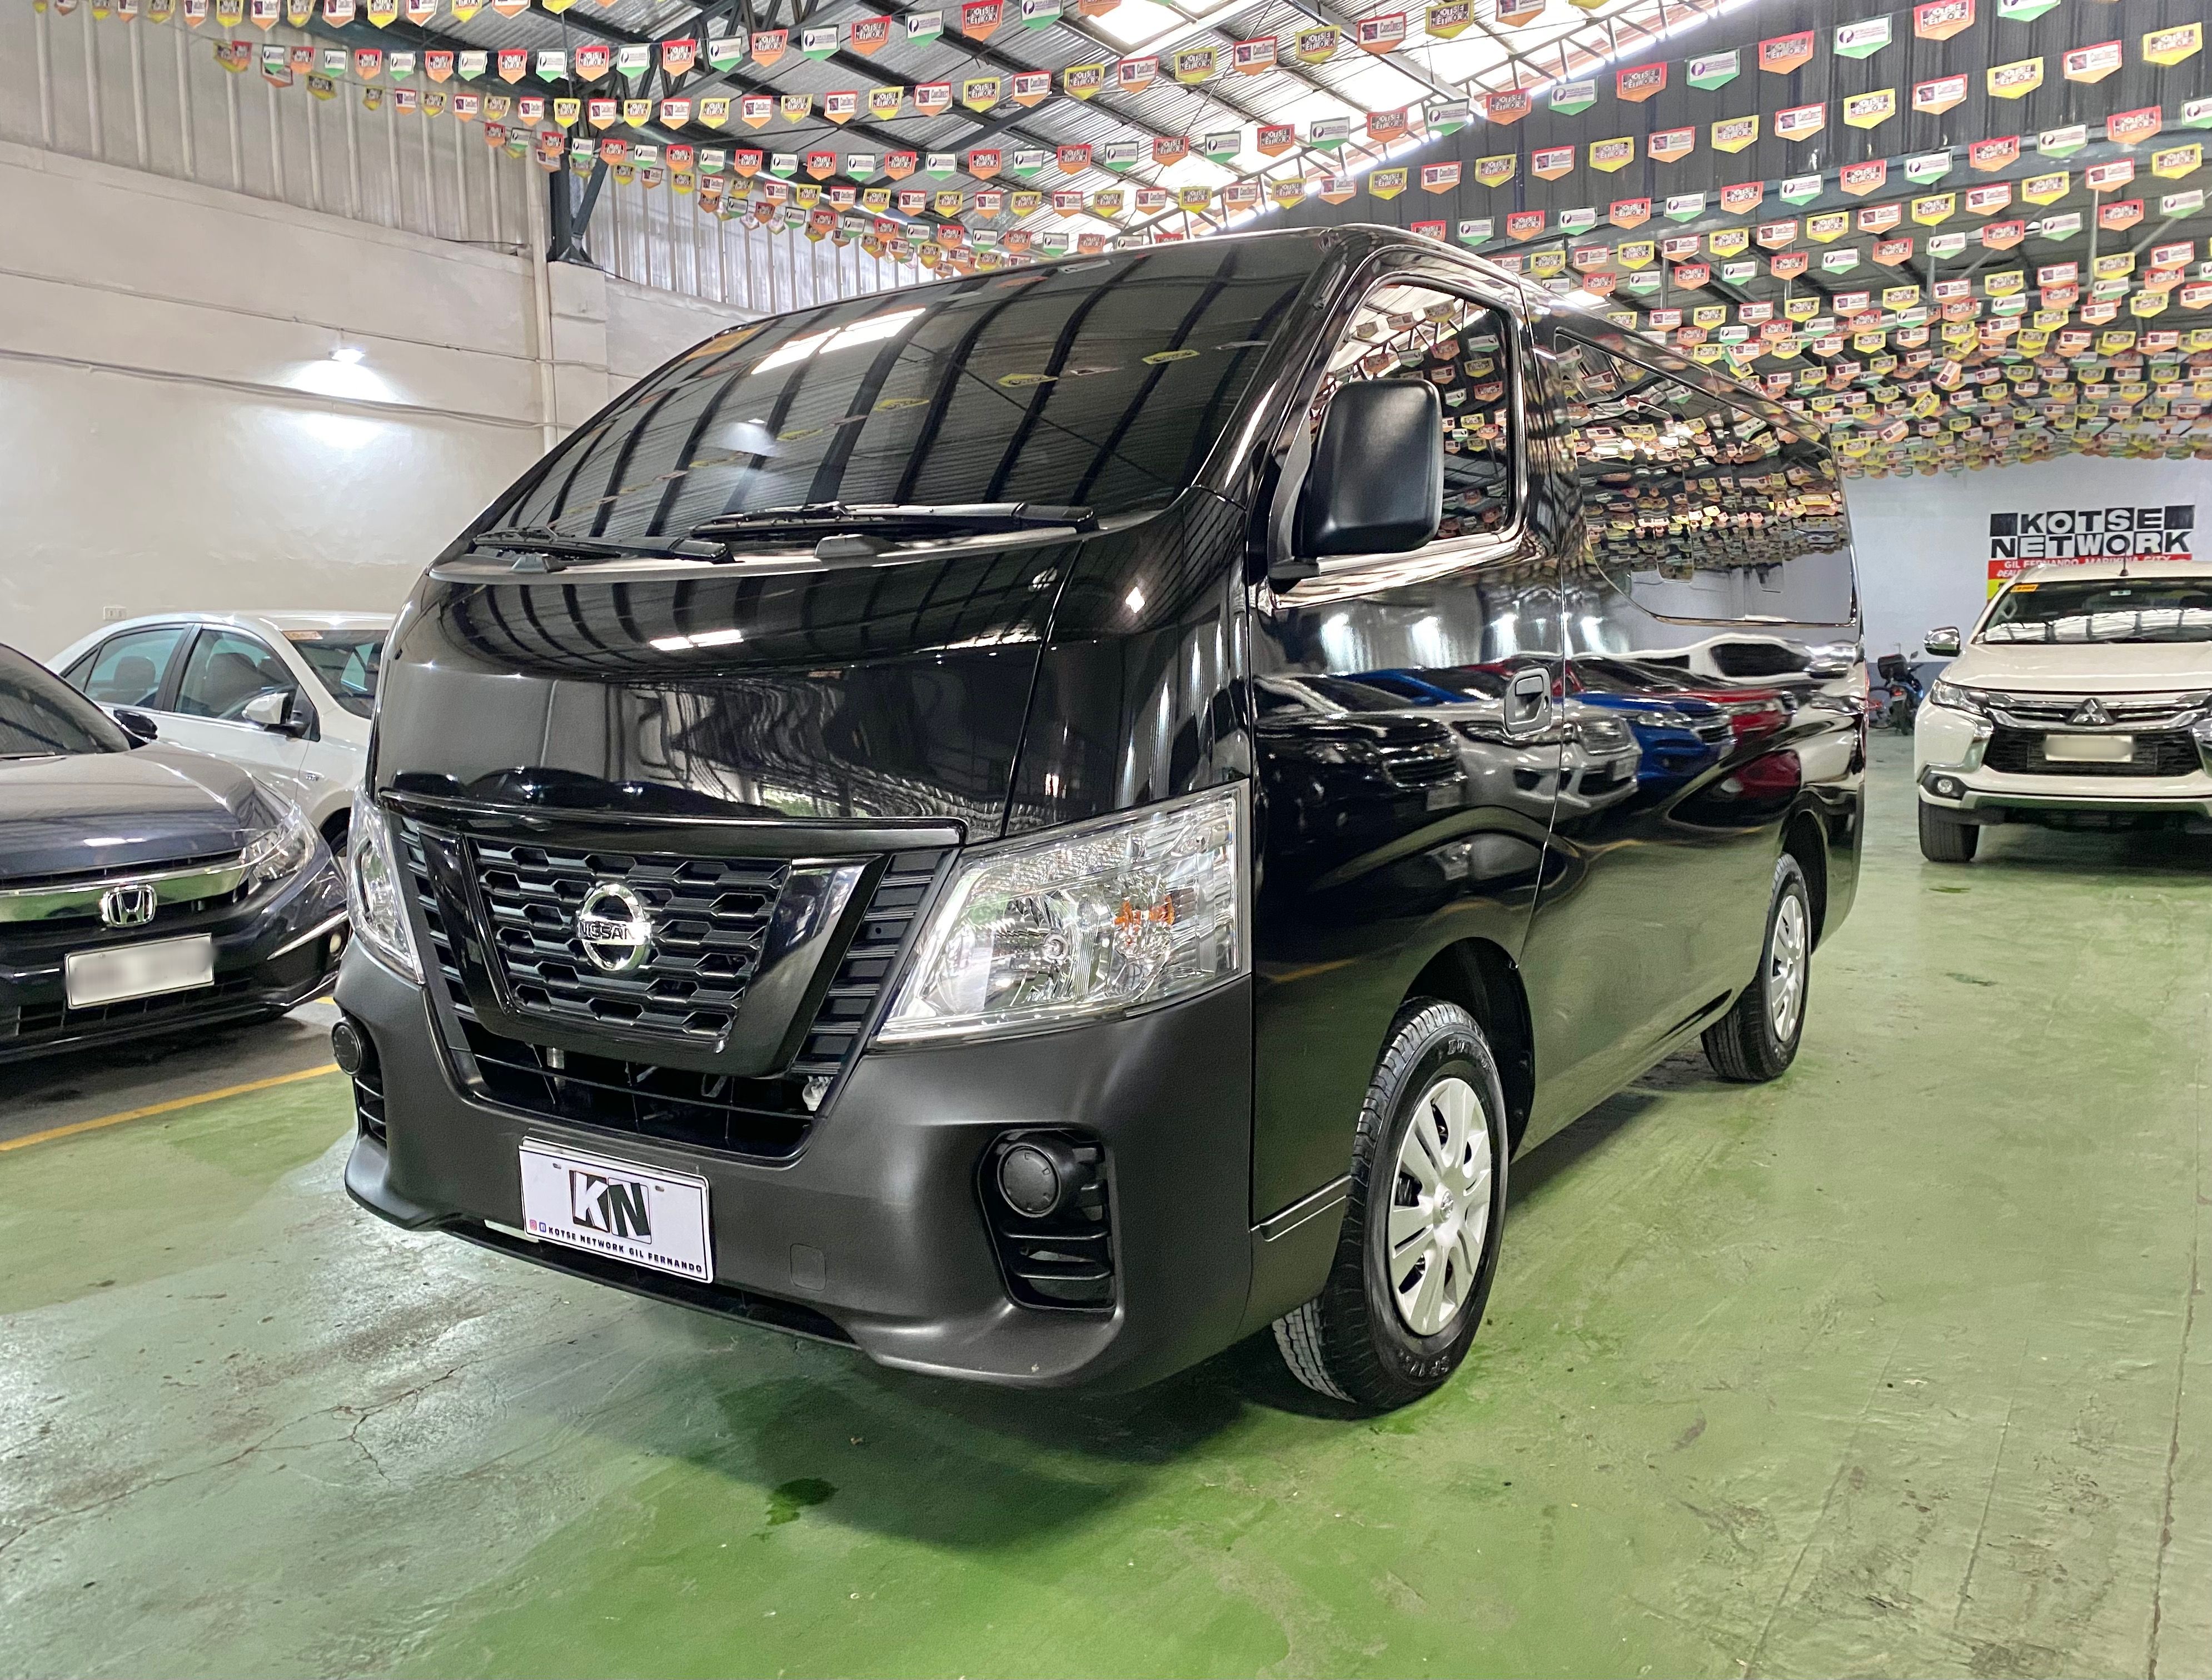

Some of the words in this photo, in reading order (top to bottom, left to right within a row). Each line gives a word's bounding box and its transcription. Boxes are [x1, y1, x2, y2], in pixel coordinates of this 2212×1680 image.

[2021, 508, 2162, 534] KOTSE
[1991, 531, 2191, 558] NETWORK
[578, 921, 636, 940] NISSAN
[573, 1171, 651, 1238] KN
[549, 1227, 576, 1240] KOTSE
[580, 1235, 624, 1254] NETWORK
[629, 1248, 644, 1259] GIL
[648, 1253, 702, 1273] FERNANDO
